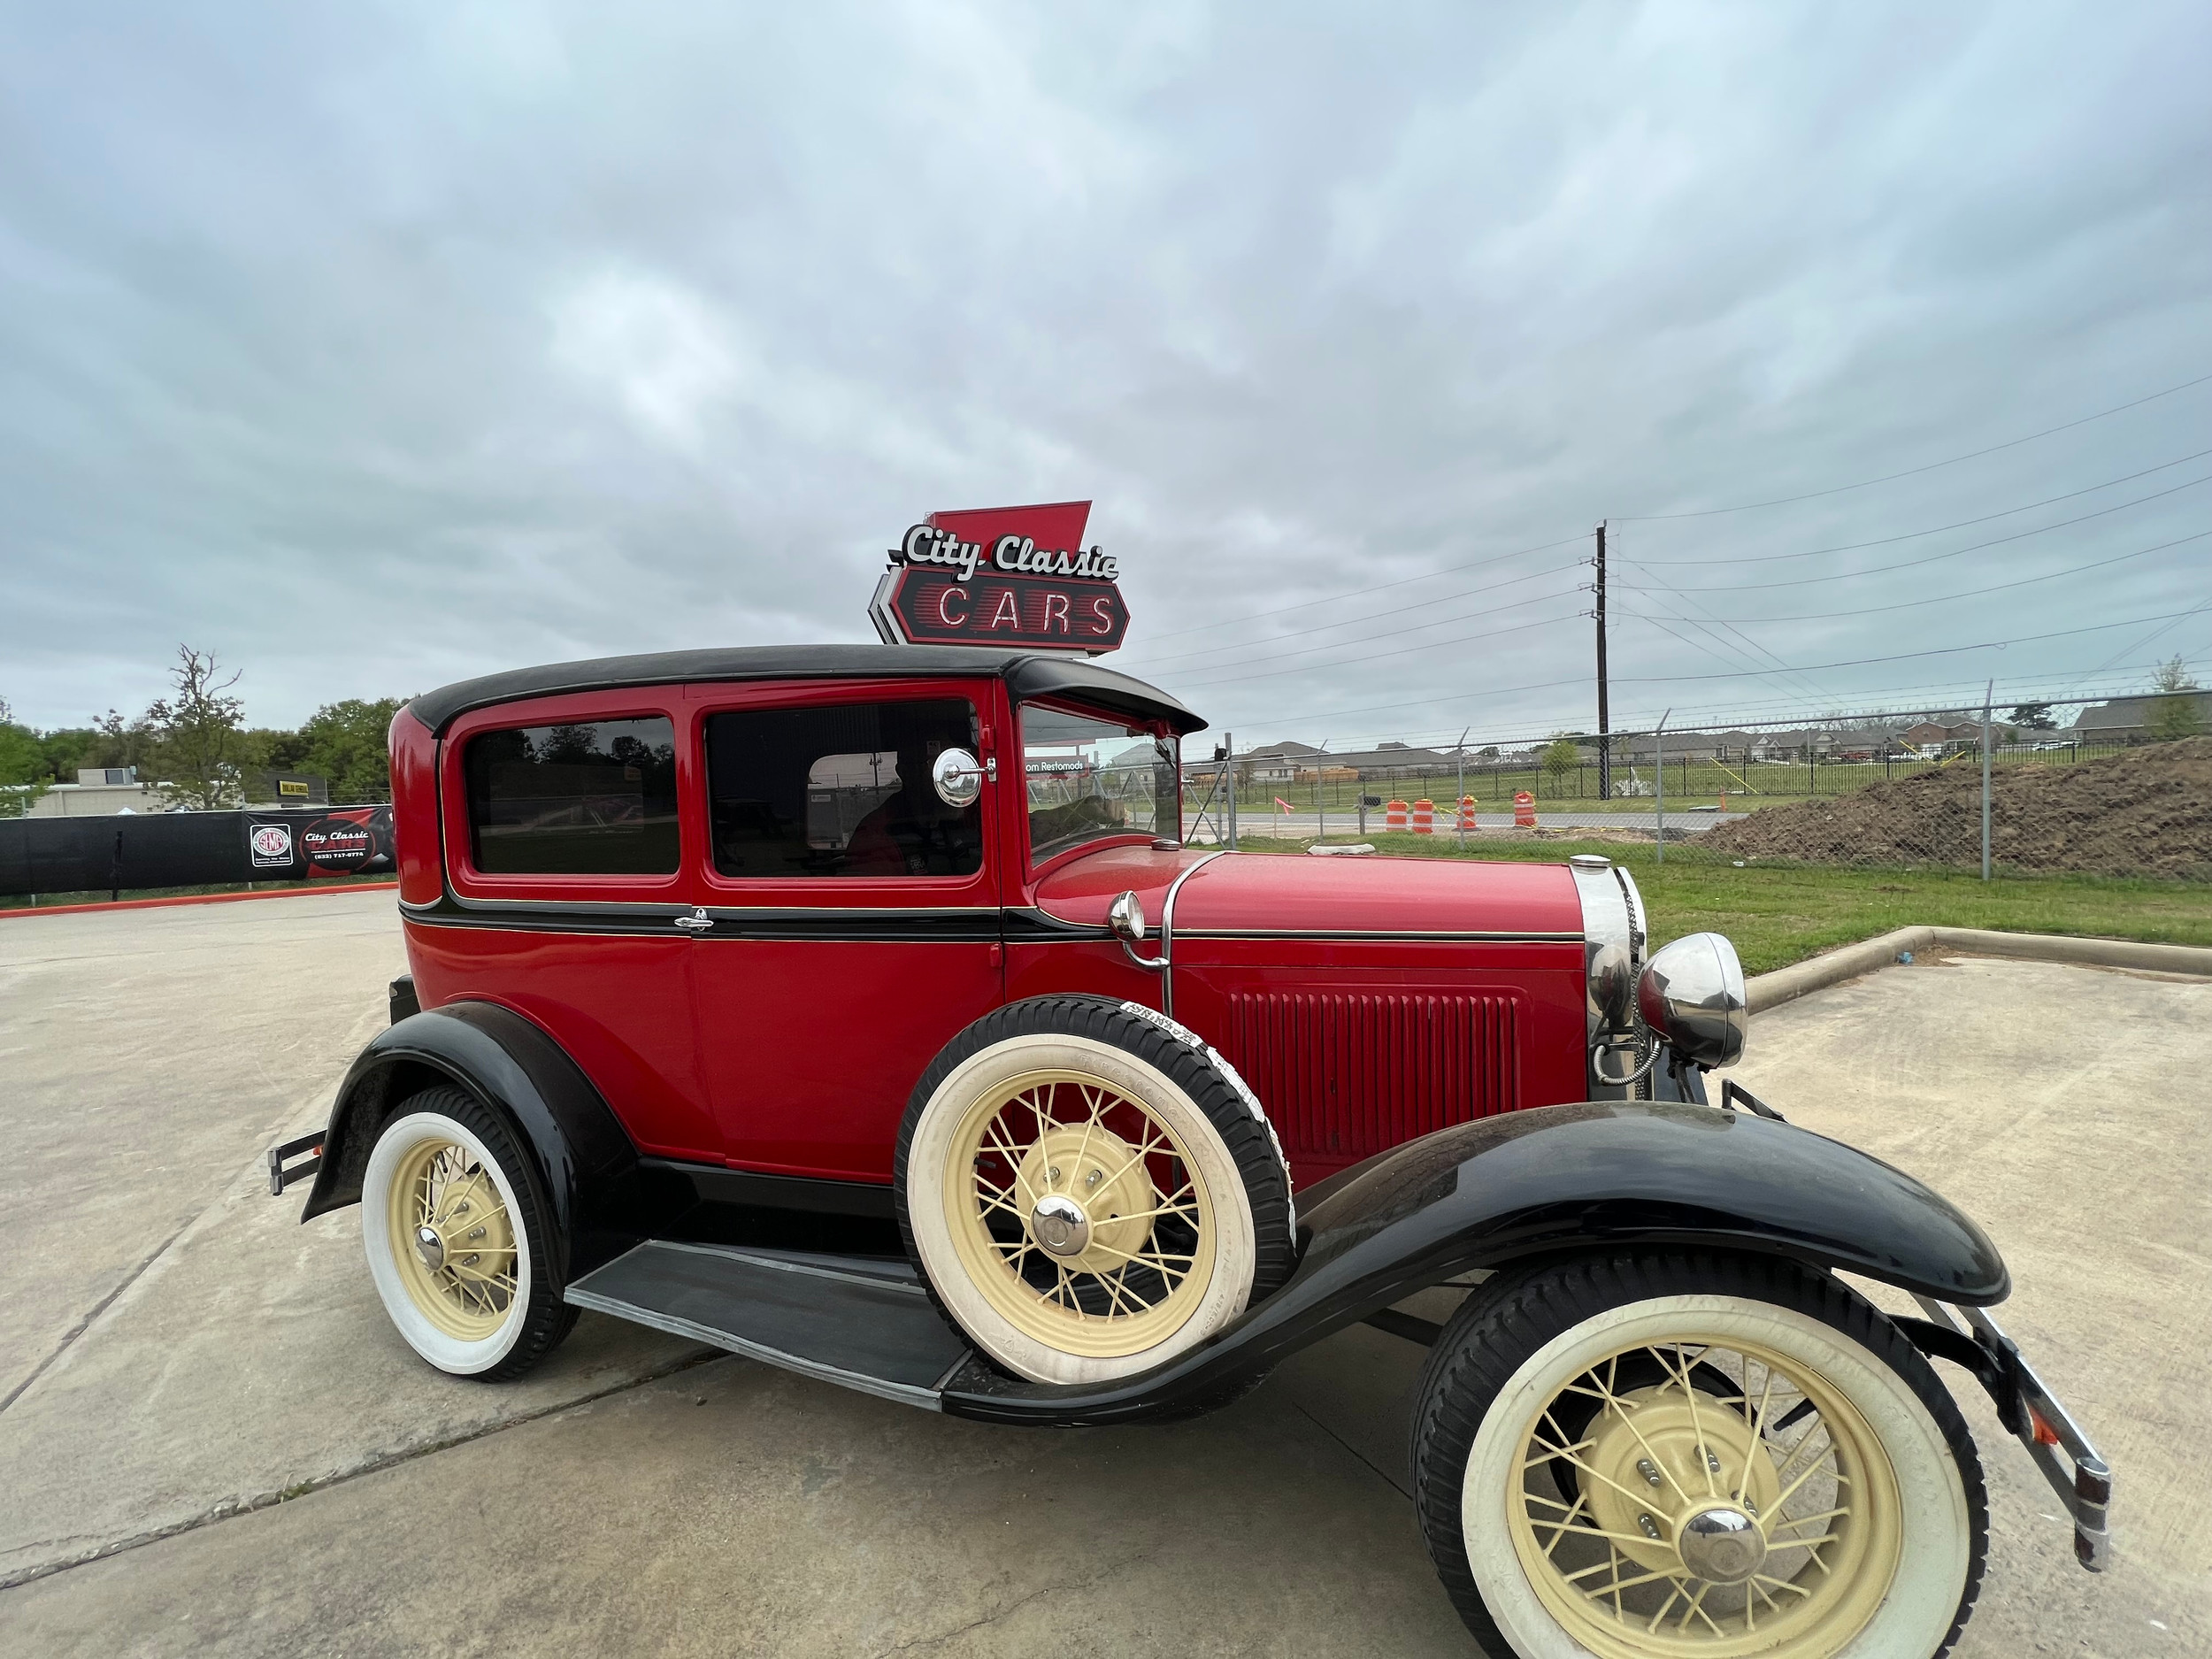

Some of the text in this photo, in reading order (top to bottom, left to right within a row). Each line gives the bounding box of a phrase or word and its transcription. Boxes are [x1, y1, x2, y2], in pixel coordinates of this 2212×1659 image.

[905, 525, 1118, 582] City Classic
[938, 586, 1113, 635] CARS
[1041, 760, 1083, 772] Restomods
[259, 832, 283, 851] SEMA
[305, 831, 369, 843] City Classic
